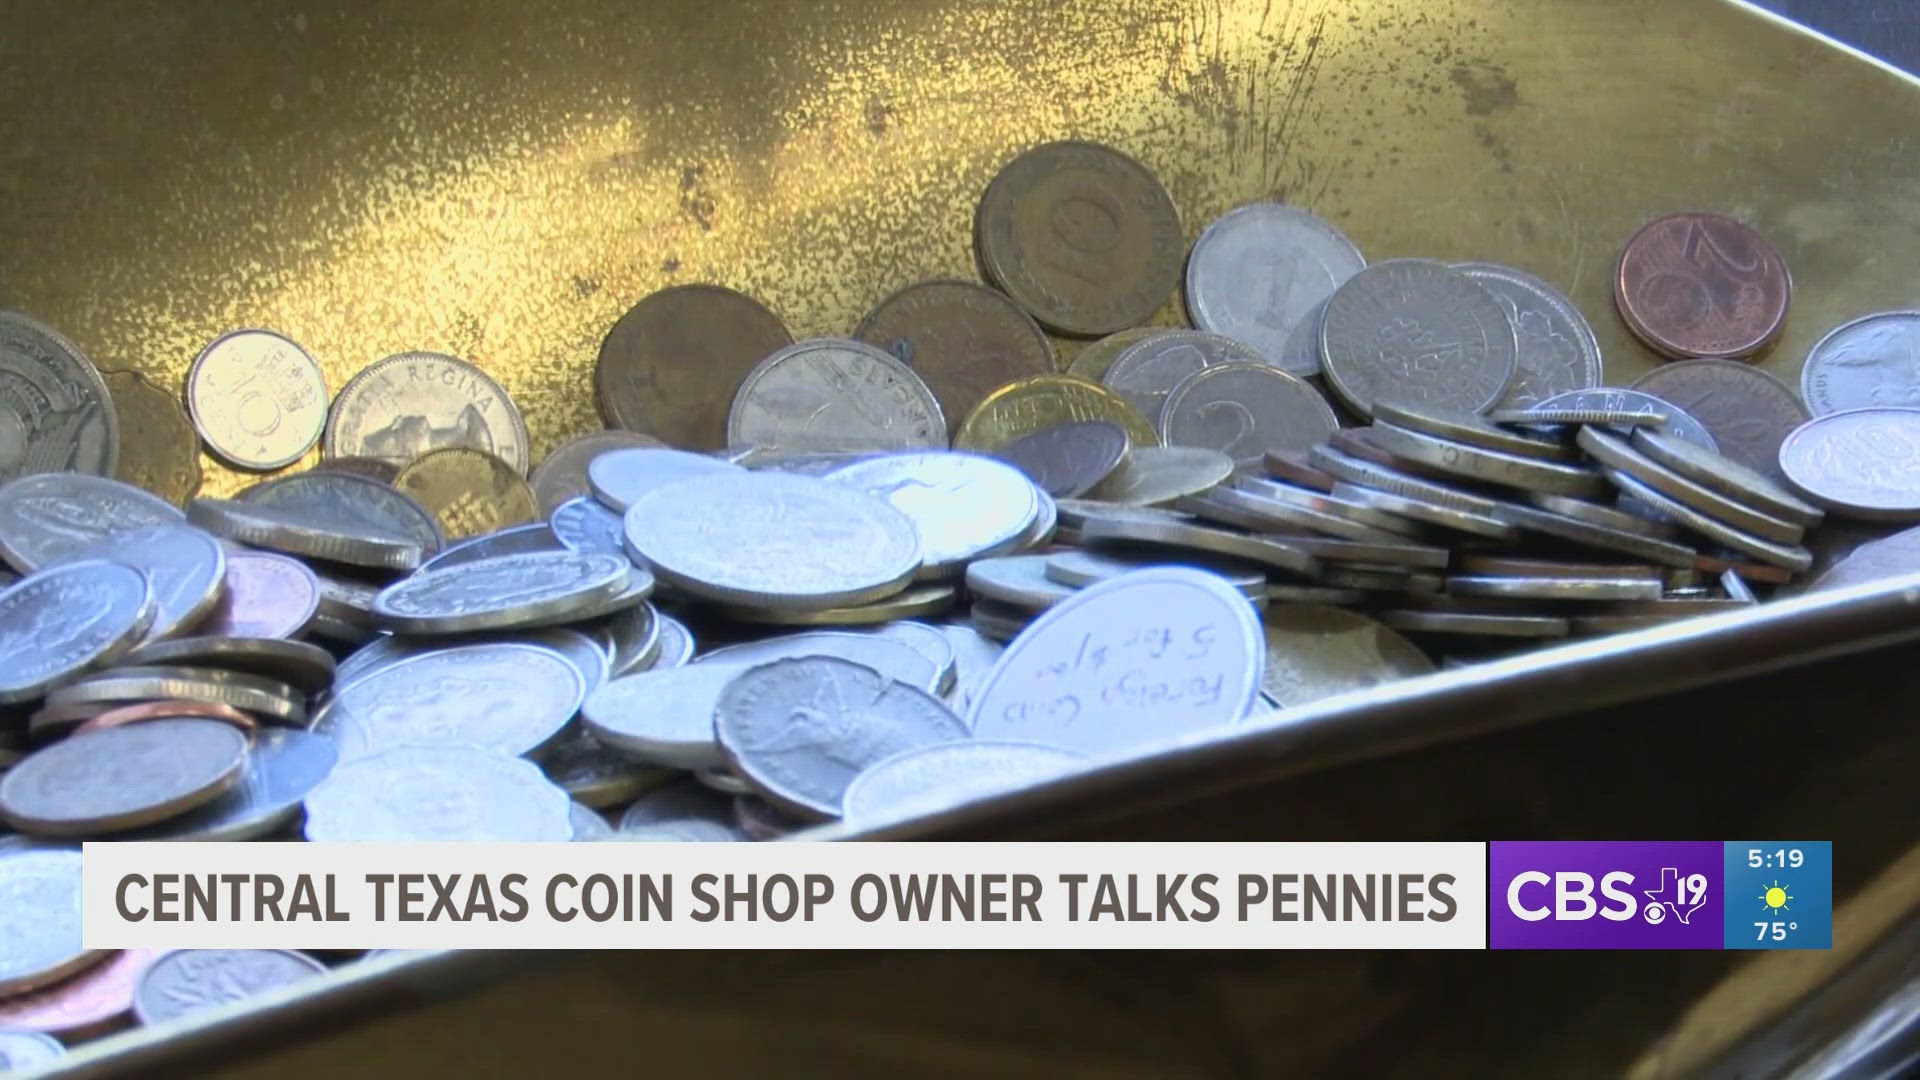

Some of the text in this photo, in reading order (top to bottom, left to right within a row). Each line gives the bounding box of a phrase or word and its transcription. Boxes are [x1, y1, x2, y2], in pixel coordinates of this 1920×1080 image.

[405, 361, 500, 415] REGINA
[1122, 627, 1172, 659] for
[1187, 624, 1215, 660] 5
[1101, 668, 1223, 707] Foreign
